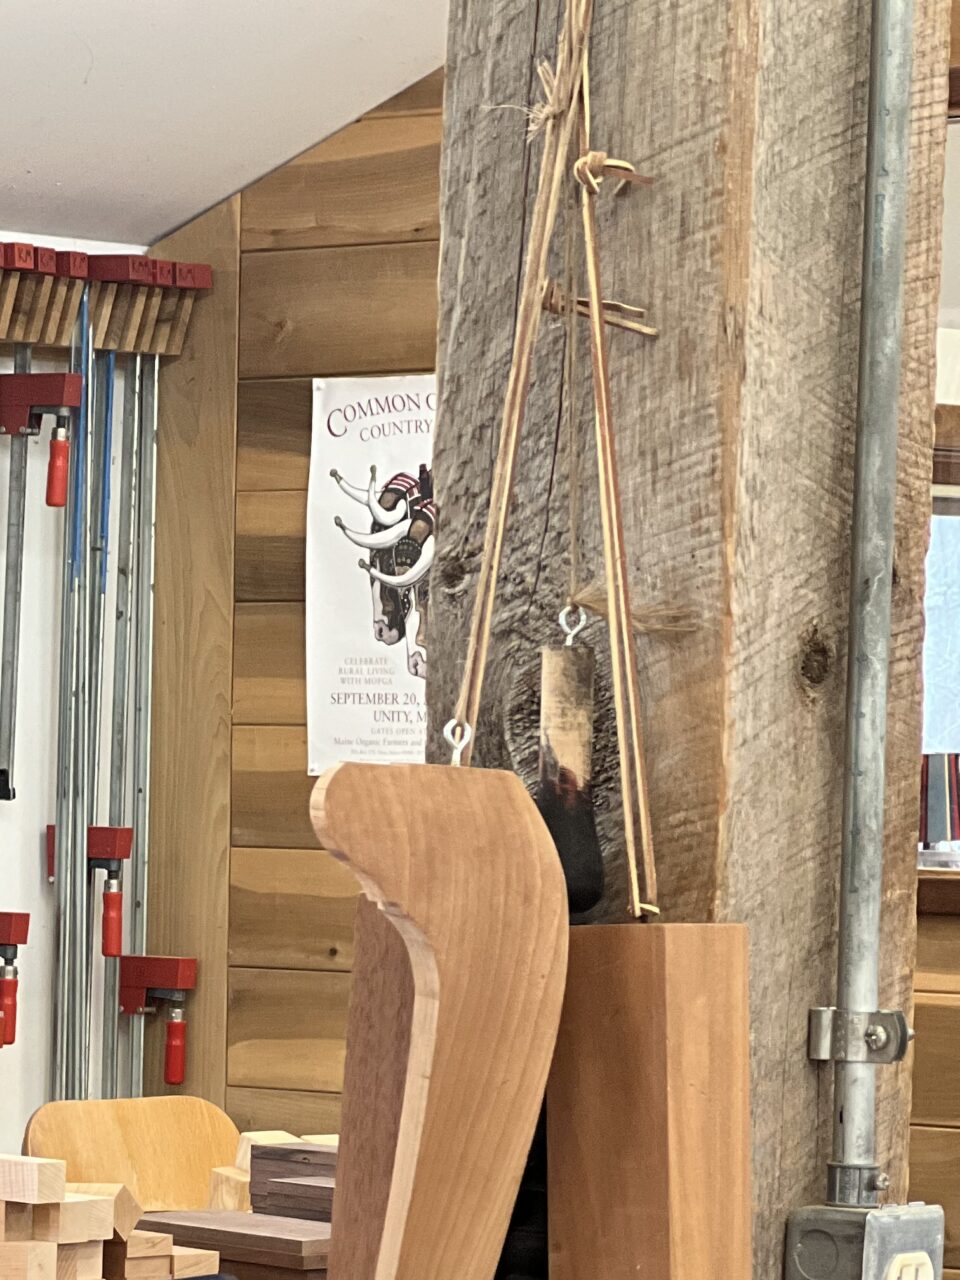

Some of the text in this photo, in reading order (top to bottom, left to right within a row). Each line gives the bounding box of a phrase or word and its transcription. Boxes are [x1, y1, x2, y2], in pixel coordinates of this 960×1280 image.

[327, 393, 421, 438] COMMON
[360, 419, 433, 442] COUNTRY
[344, 657, 388, 666] CELEBRATE
[338, 667, 395, 676] RURAL LIVING
[340, 677, 361, 685] WITH
[330, 692, 420, 707] SEPTEMBER 20,
[373, 710, 413, 724] UNITY,
[334, 737, 353, 746] Maine
[355, 737, 381, 747] Organic
[410, 737, 423, 746] and
